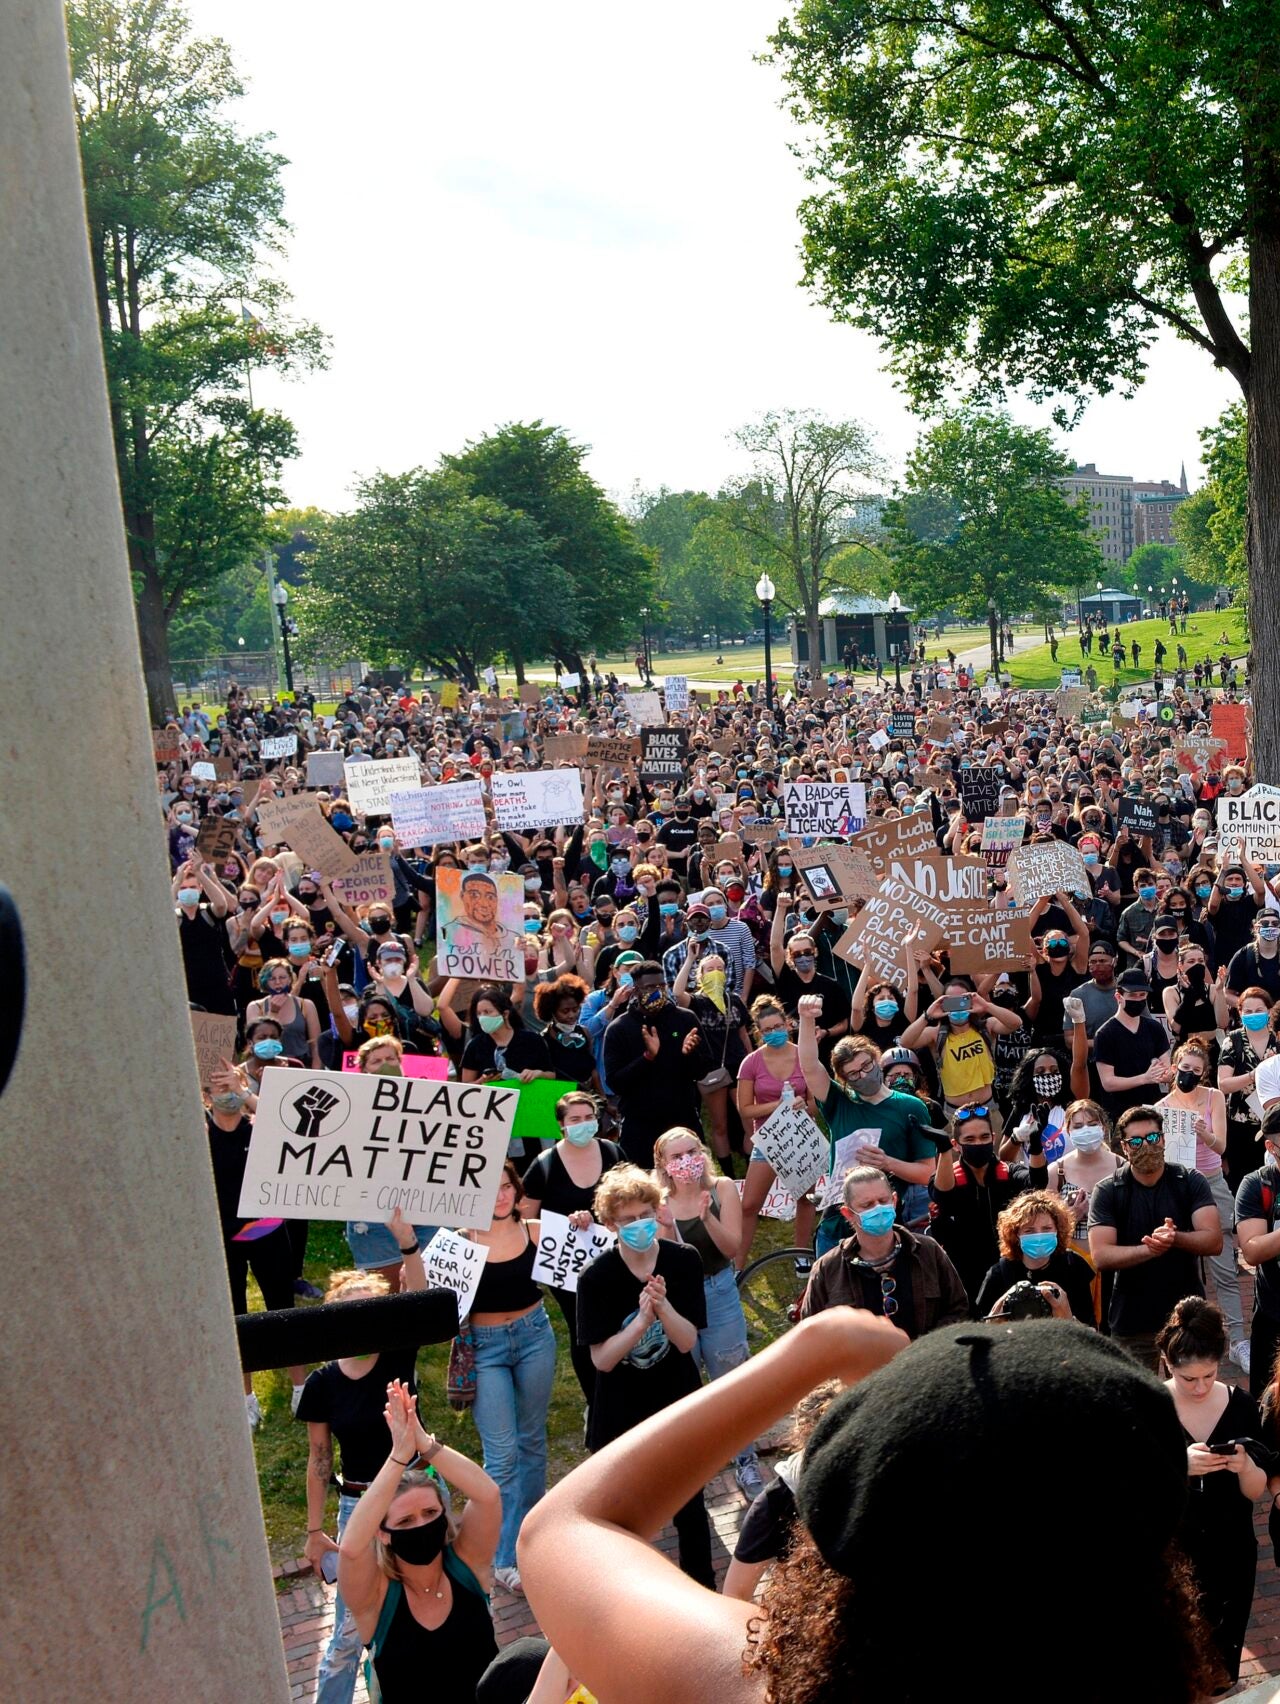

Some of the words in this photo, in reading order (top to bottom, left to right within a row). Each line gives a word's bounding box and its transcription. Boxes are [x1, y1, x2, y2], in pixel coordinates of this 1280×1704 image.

[649, 735, 680, 745] BLACK
[1184, 738, 1221, 748] JUSTICE
[587, 750, 599, 758] NO
[601, 750, 629, 760] PEACE
[646, 748, 678, 758] LIVES
[348, 766, 358, 777] I
[360, 764, 394, 776] Understand
[642, 762, 682, 772] MATTER
[381, 773, 418, 784] Understand
[962, 769, 999, 784] BLACK
[510, 791, 526, 799] many
[787, 787, 801, 801] A
[805, 786, 850, 801] BADGE
[962, 784, 999, 797] LIVES
[495, 797, 527, 805] DEATHS
[839, 799, 852, 817] A
[962, 800, 999, 815] MATTER
[1134, 805, 1154, 816] Nah.
[788, 818, 838, 834] LICENSE
[897, 816, 934, 840] Lucha
[888, 847, 904, 859] mi
[906, 838, 938, 856] Lucha
[1016, 851, 1065, 869] REMEMBER
[1028, 862, 1059, 876] THEIR
[891, 860, 937, 899] NO
[1027, 871, 1061, 888] NAMES
[344, 888, 388, 902] FLOYD
[879, 878, 903, 900] NO
[900, 891, 950, 929] JUSTICE
[865, 897, 890, 918] NO
[950, 914, 963, 926] I
[950, 930, 966, 946] I
[968, 924, 1010, 945] CANT
[448, 942, 481, 955] rest
[490, 944, 515, 960] in
[858, 930, 900, 960] LIVES
[446, 955, 519, 979] POWER
[950, 1040, 984, 1062] VANS
[997, 1045, 1030, 1058] MATT
[372, 1079, 514, 1122] BLACK
[370, 1116, 484, 1149] LIVES
[759, 1119, 779, 1139] Show
[772, 1122, 791, 1141] time
[792, 1110, 802, 1119] in
[768, 1137, 793, 1162] history
[794, 1118, 810, 1135] when
[781, 1151, 795, 1164] lives
[797, 1127, 815, 1149] matter
[278, 1142, 487, 1188] MATTER
[781, 1168, 793, 1179] like
[797, 1152, 807, 1167] you
[810, 1137, 819, 1149] say
[796, 1163, 811, 1177] they
[812, 1153, 820, 1162] do
[259, 1182, 346, 1207] SILENCE
[377, 1185, 481, 1217] COMPLIANCE
[435, 1236, 456, 1255] SEE
[539, 1236, 556, 1270] NO
[553, 1222, 578, 1288] JUSTICE
[572, 1248, 587, 1273] NO
[430, 1256, 458, 1274] HEAR
[428, 1270, 469, 1293] STAND
